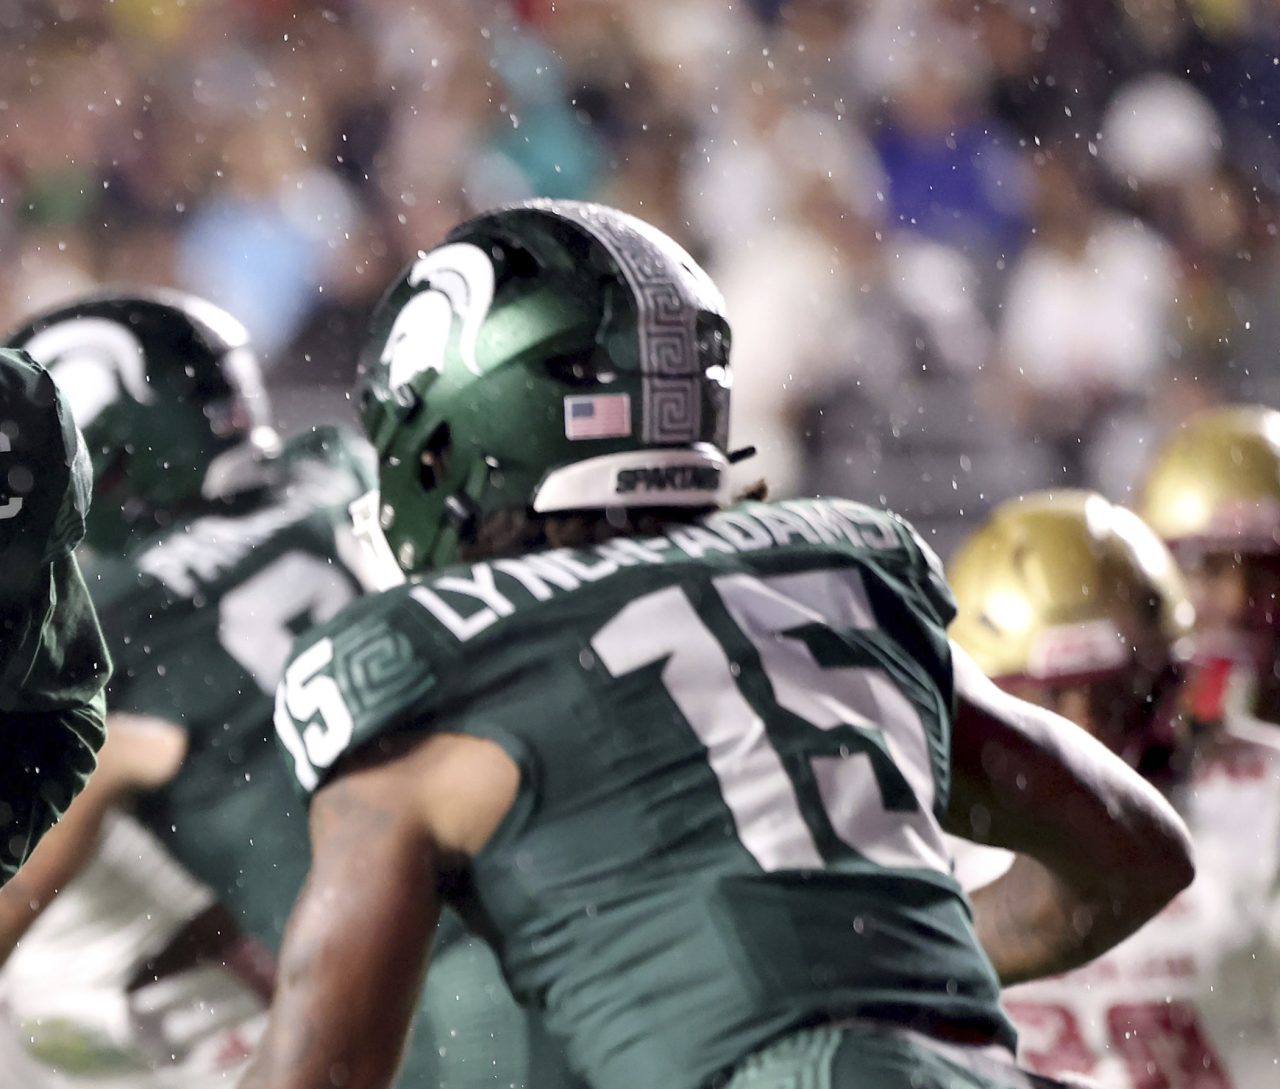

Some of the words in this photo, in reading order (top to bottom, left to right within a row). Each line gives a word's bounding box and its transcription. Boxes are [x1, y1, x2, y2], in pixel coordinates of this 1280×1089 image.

[410, 500, 902, 642] LYNCH-ADAMS
[273, 636, 354, 792] 15
[589, 568, 954, 873] 15
